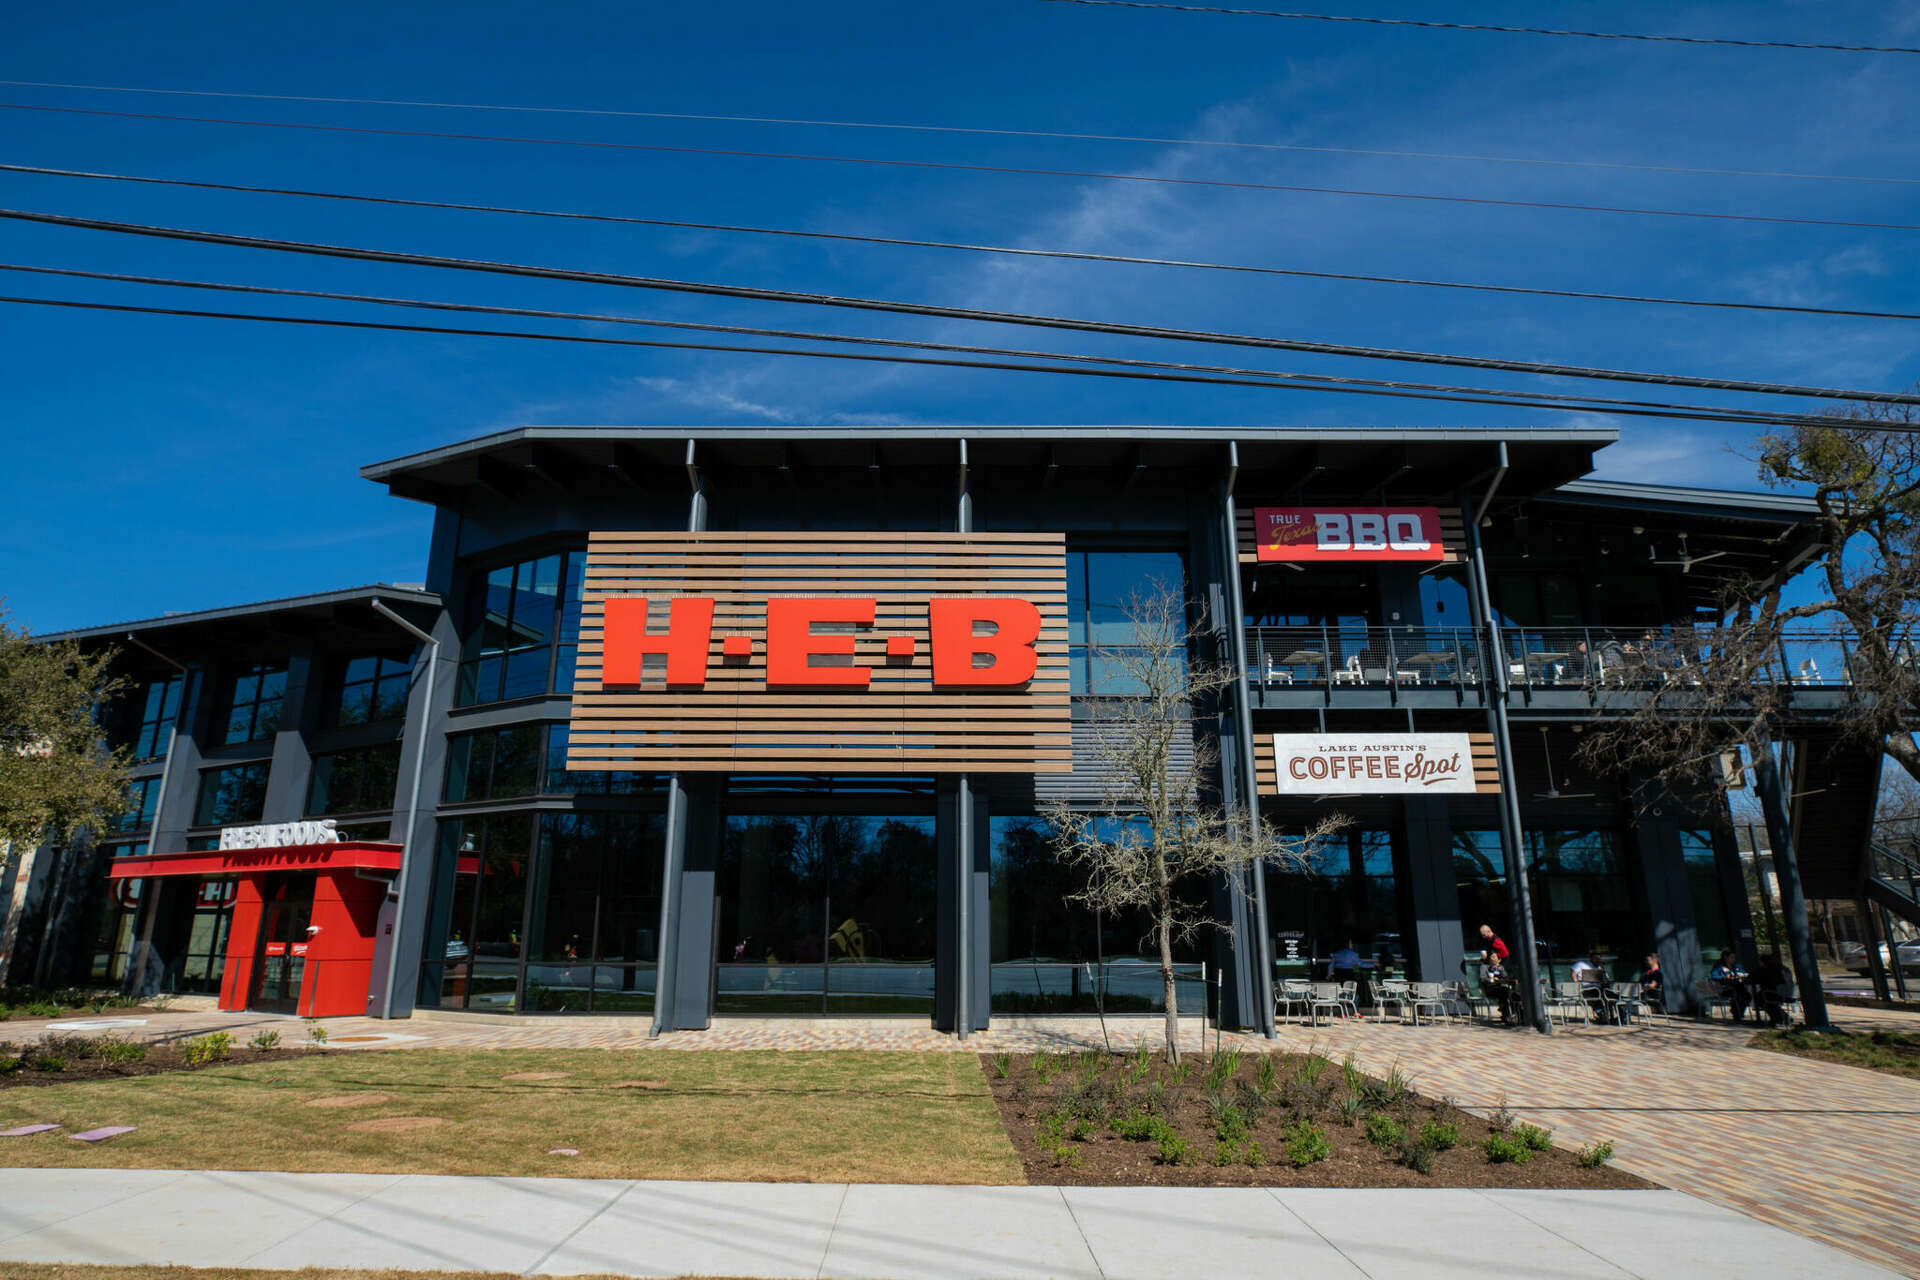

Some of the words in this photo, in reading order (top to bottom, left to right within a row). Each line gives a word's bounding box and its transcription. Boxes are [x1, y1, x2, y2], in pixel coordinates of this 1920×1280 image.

[1269, 514, 1301, 525] TRUE
[1314, 513, 1432, 551] BBQ
[1269, 520, 1323, 550] Texas
[1319, 744, 1358, 752] LAKE
[1363, 744, 1428, 752] AUSTIN'S
[1289, 756, 1402, 780] COFFEE
[1404, 752, 1462, 784] Spot
[219, 824, 276, 850] FRESH
[275, 819, 339, 846] FOODS
